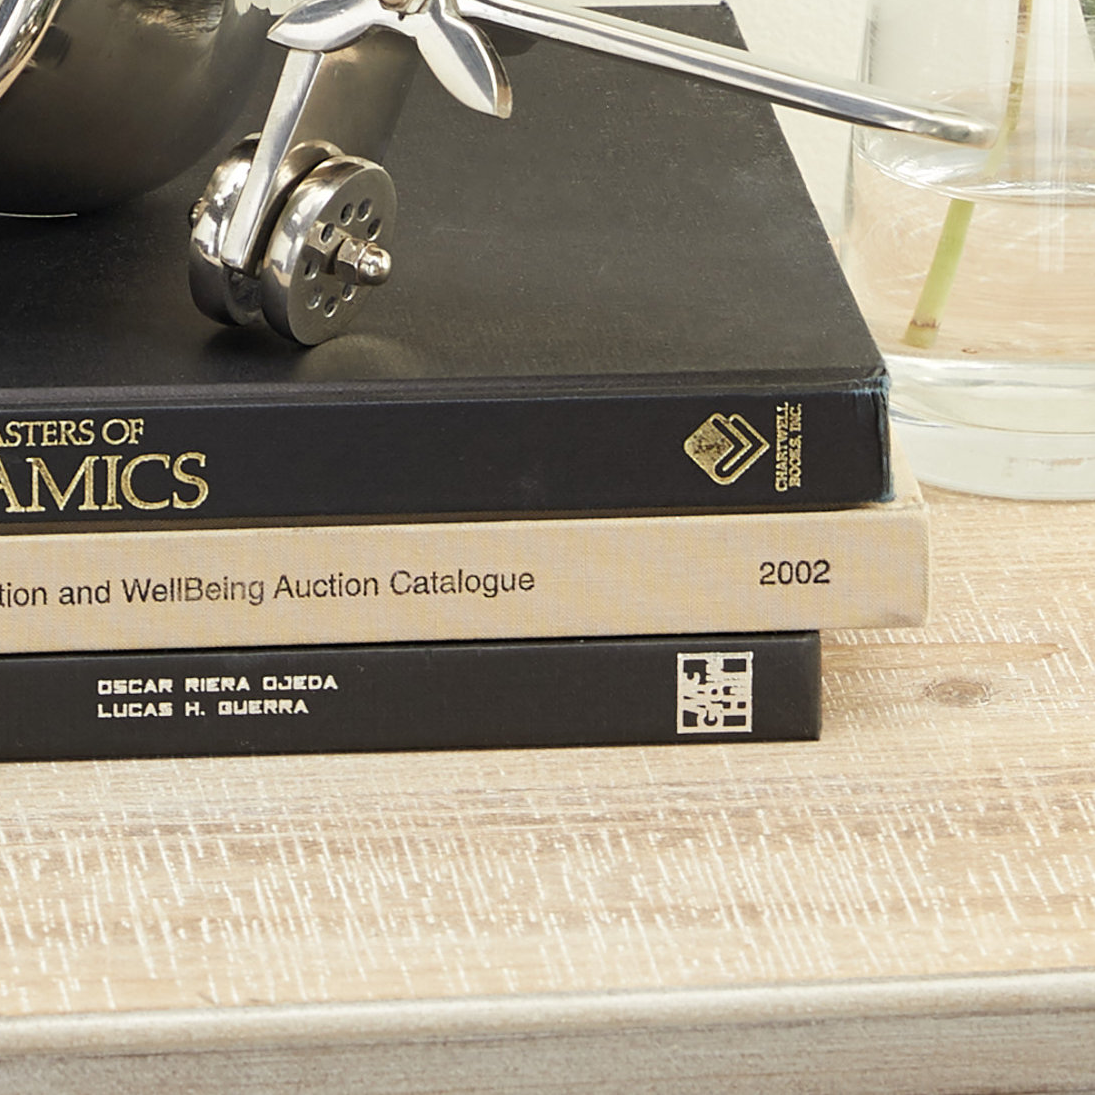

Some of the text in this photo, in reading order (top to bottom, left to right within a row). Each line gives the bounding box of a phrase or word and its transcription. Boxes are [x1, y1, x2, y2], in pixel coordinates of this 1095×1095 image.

[102, 417, 145, 447] OF
[774, 401, 789, 493] CHARTWELL
[759, 559, 831, 586] 2002
[58, 580, 111, 606] and
[121, 576, 265, 606] WellBeing
[273, 572, 379, 600] Auction
[389, 569, 536, 598] Catalogue
[97, 674, 339, 695] OSCAR RIERA OJEDA
[97, 698, 309, 718] LUCAS H. GUERRA
